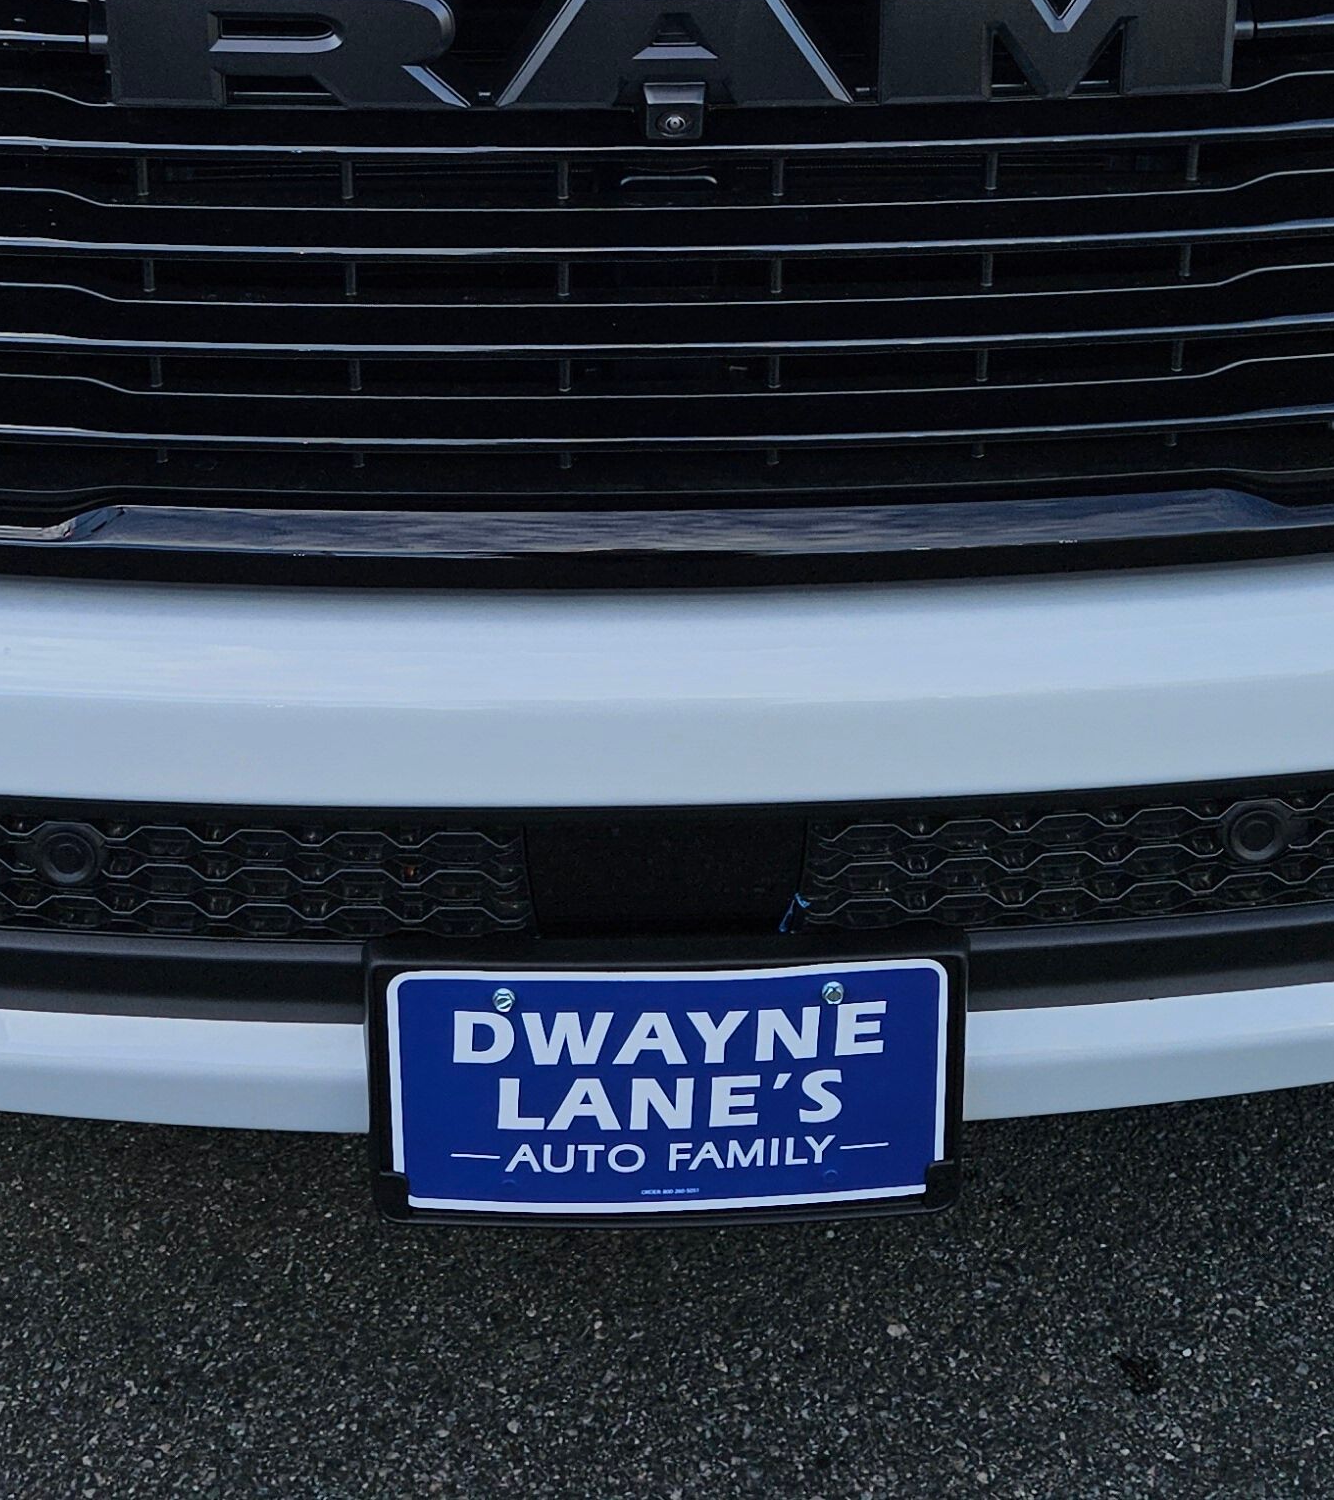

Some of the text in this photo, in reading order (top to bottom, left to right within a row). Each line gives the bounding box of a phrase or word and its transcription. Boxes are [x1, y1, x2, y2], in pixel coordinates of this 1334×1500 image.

[453, 1000, 888, 1066] DWAYNE
[497, 1069, 843, 1131] LANE'S
[504, 1134, 836, 1173] AUTO FAMILY
